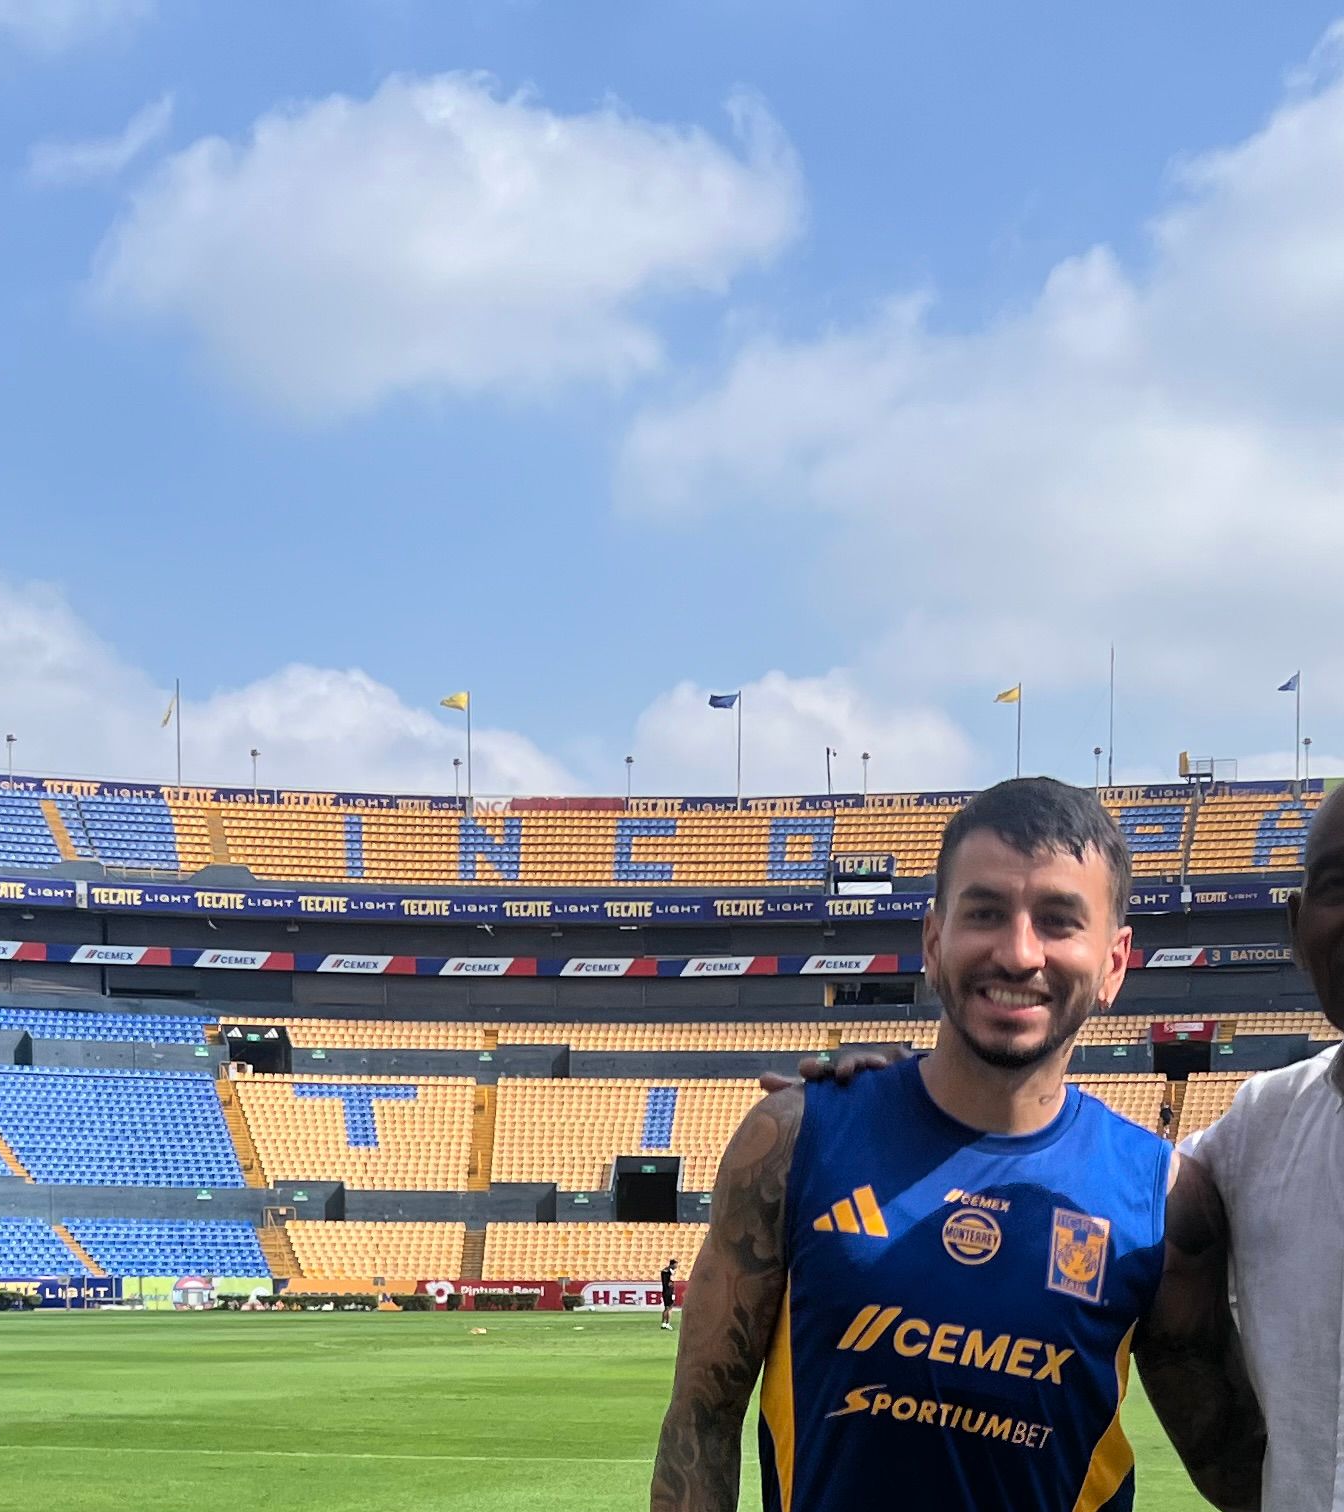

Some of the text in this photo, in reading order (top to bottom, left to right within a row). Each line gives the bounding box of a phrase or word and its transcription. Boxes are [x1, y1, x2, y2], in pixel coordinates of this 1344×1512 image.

[43, 780, 155, 799] TECATE LIGHT
[160, 786, 270, 804] TECATE LIGHT
[1150, 788, 1194, 799] LIGHT
[280, 792, 389, 809] TECATE LIGHT
[747, 797, 857, 811] TECATE LIGHT
[835, 855, 887, 874] TECATE
[28, 887, 74, 898] LIGHT
[91, 888, 191, 906] TECATE LIGHT
[1129, 893, 1171, 905] GHT
[194, 891, 294, 910] TECATE LIGHT
[298, 896, 396, 914] TECATE LIGHT
[400, 899, 498, 916] TECATE LIGHT
[714, 899, 814, 916] TECATE LIGHT
[825, 898, 875, 916] TECATE
[877, 901, 923, 911] LIGHT
[503, 901, 599, 917] TECATE LIGHT
[604, 901, 701, 918] TECATE LIGHT
[96, 950, 134, 961] CEMEX
[220, 955, 256, 966] CEMEX
[1162, 954, 1193, 963] CEMEX
[1212, 949, 1221, 961] 3
[343, 960, 378, 970] CEMEX
[464, 963, 500, 972] CEMEX
[585, 963, 620, 972] CEMEX
[705, 961, 741, 972] CEMEX
[825, 959, 861, 970] CEMEX
[961, 1193, 1011, 1212] CEMEX
[945, 1224, 999, 1247] MONTERREY
[45, 1286, 109, 1300] LIGHT
[461, 1285, 510, 1296] Pinturas
[893, 1318, 1076, 1386] CEMEX
